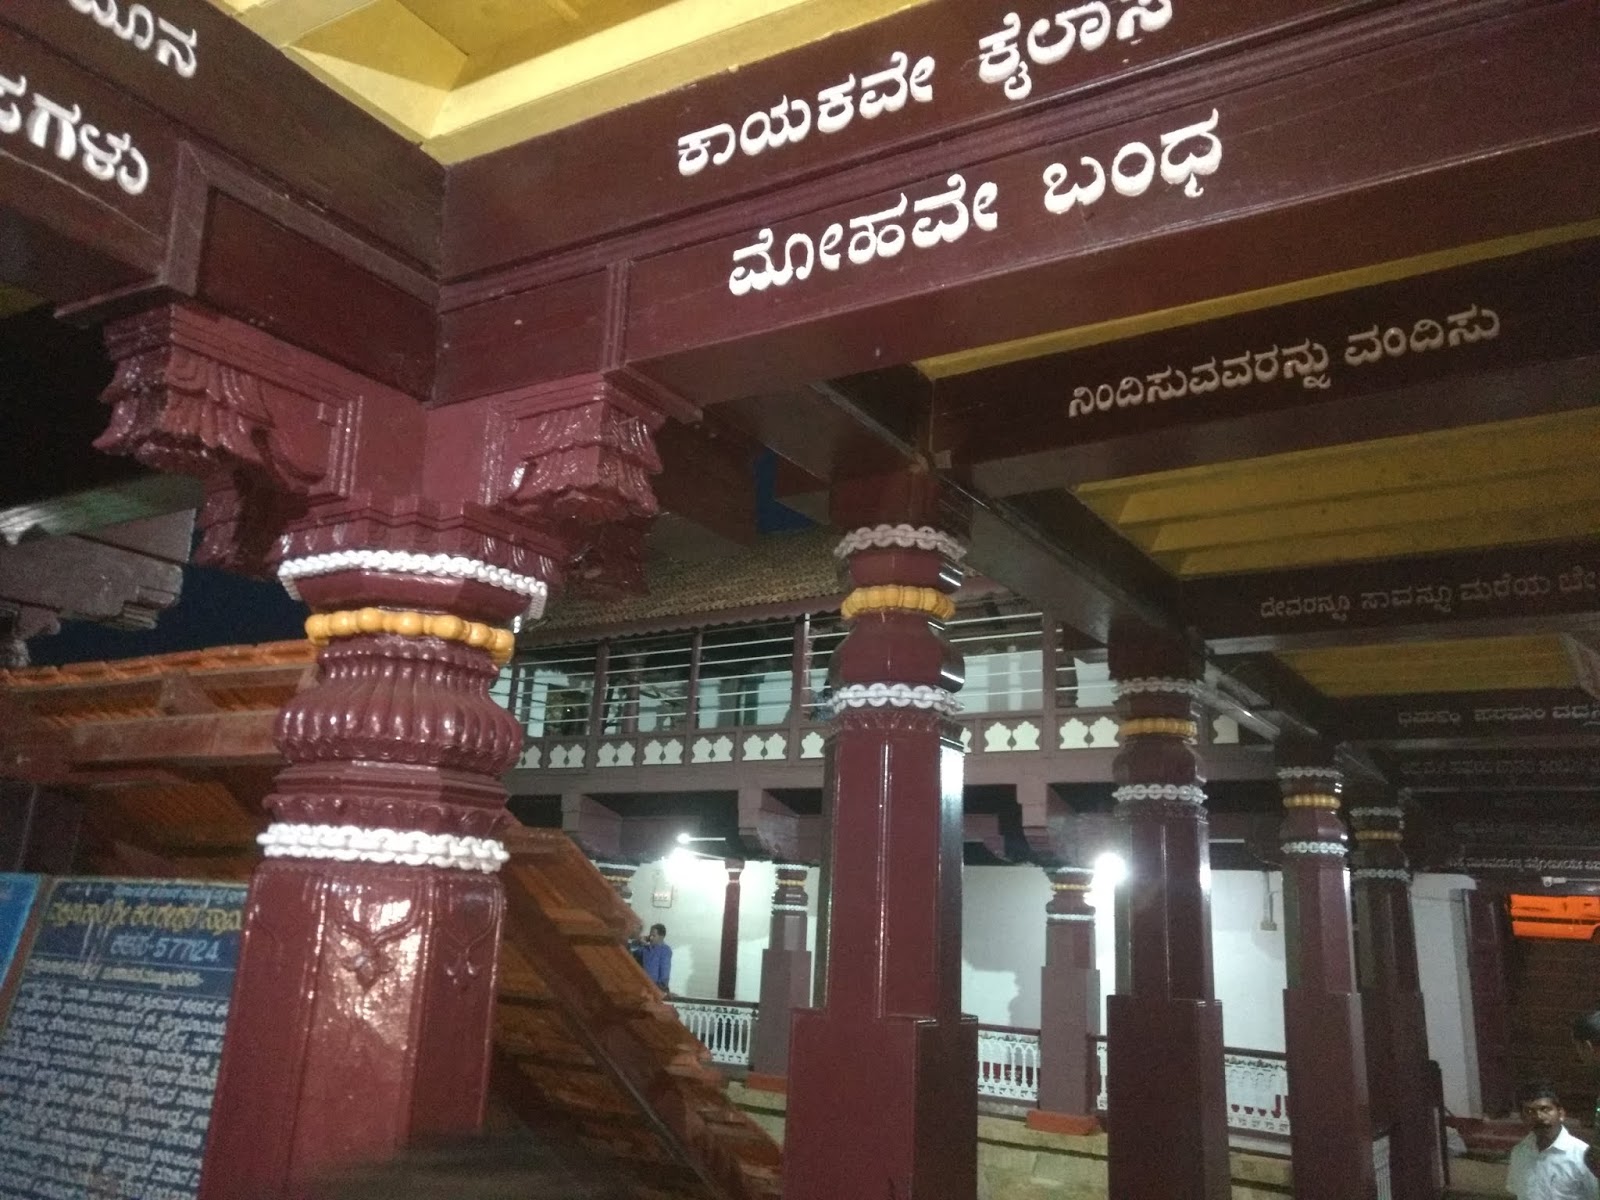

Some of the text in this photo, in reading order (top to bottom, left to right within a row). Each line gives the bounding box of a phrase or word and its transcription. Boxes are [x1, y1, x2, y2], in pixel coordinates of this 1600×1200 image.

[677, 51, 936, 177] ಕಾಯಕವೇ
[728, 108, 1223, 296] ಮೋಹವೇ ಬಂಧ
[1068, 303, 1501, 418] ನಿಂದಿಸುವವರನ್ನು ವಂದಿಸು
